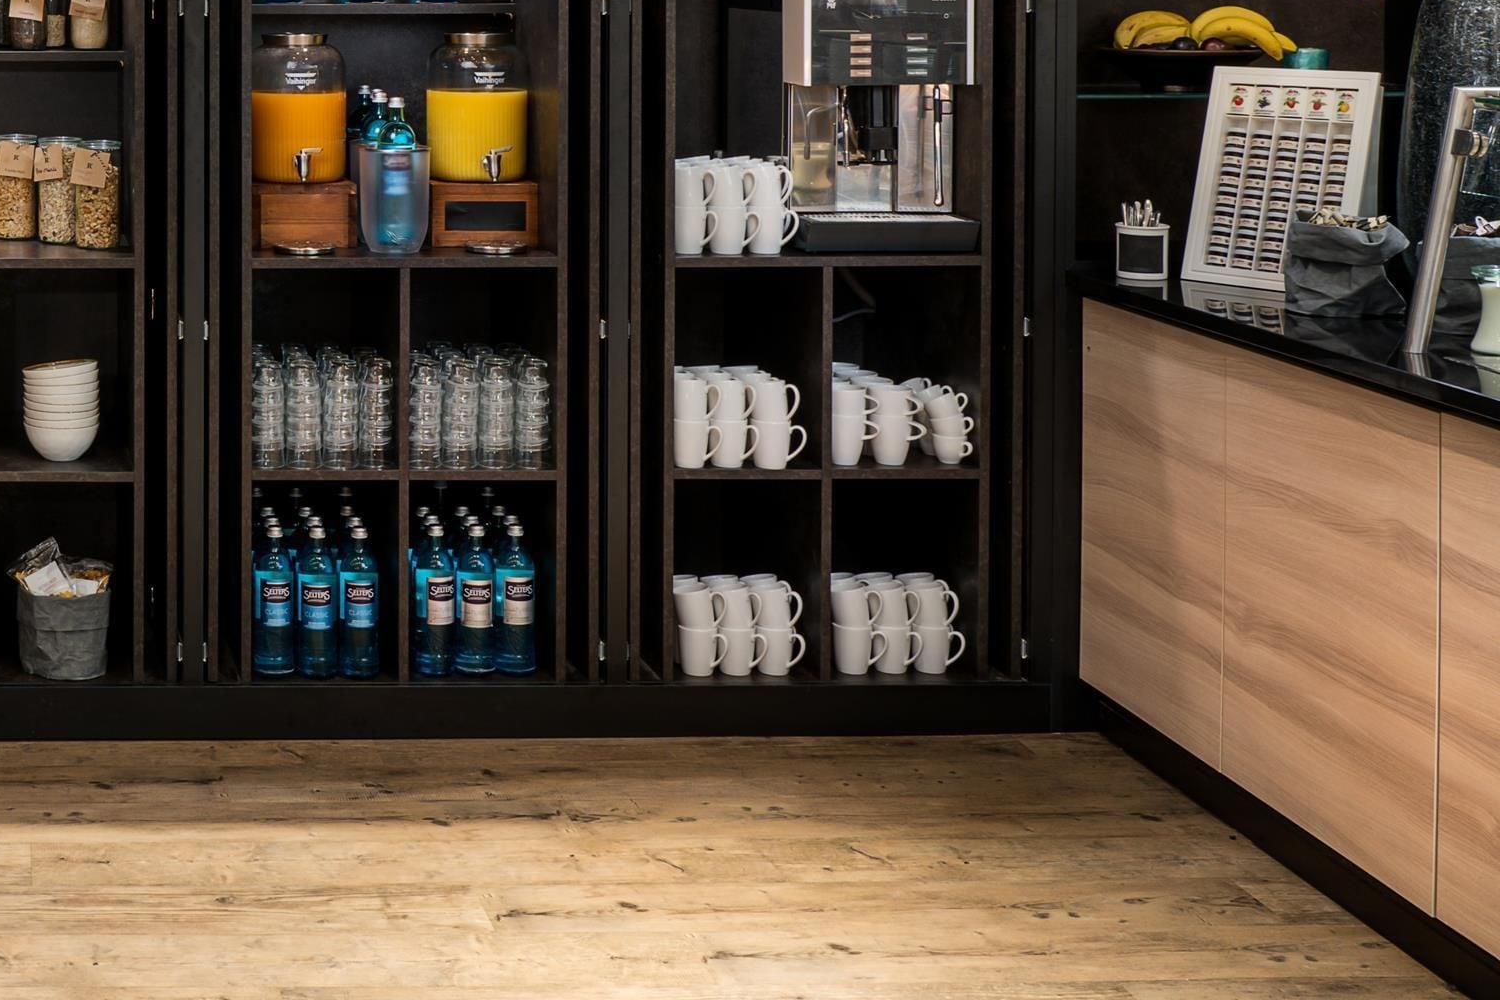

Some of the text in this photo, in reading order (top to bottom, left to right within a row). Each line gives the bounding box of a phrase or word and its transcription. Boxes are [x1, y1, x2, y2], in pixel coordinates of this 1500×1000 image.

[263, 587, 290, 597] SELTERS
[347, 587, 375, 598] SELTERS
[430, 584, 454, 595] SELTERS
[463, 588, 491, 598] SELTERS
[507, 584, 533, 595] SELTERS
[303, 590, 331, 601] SELTERS
